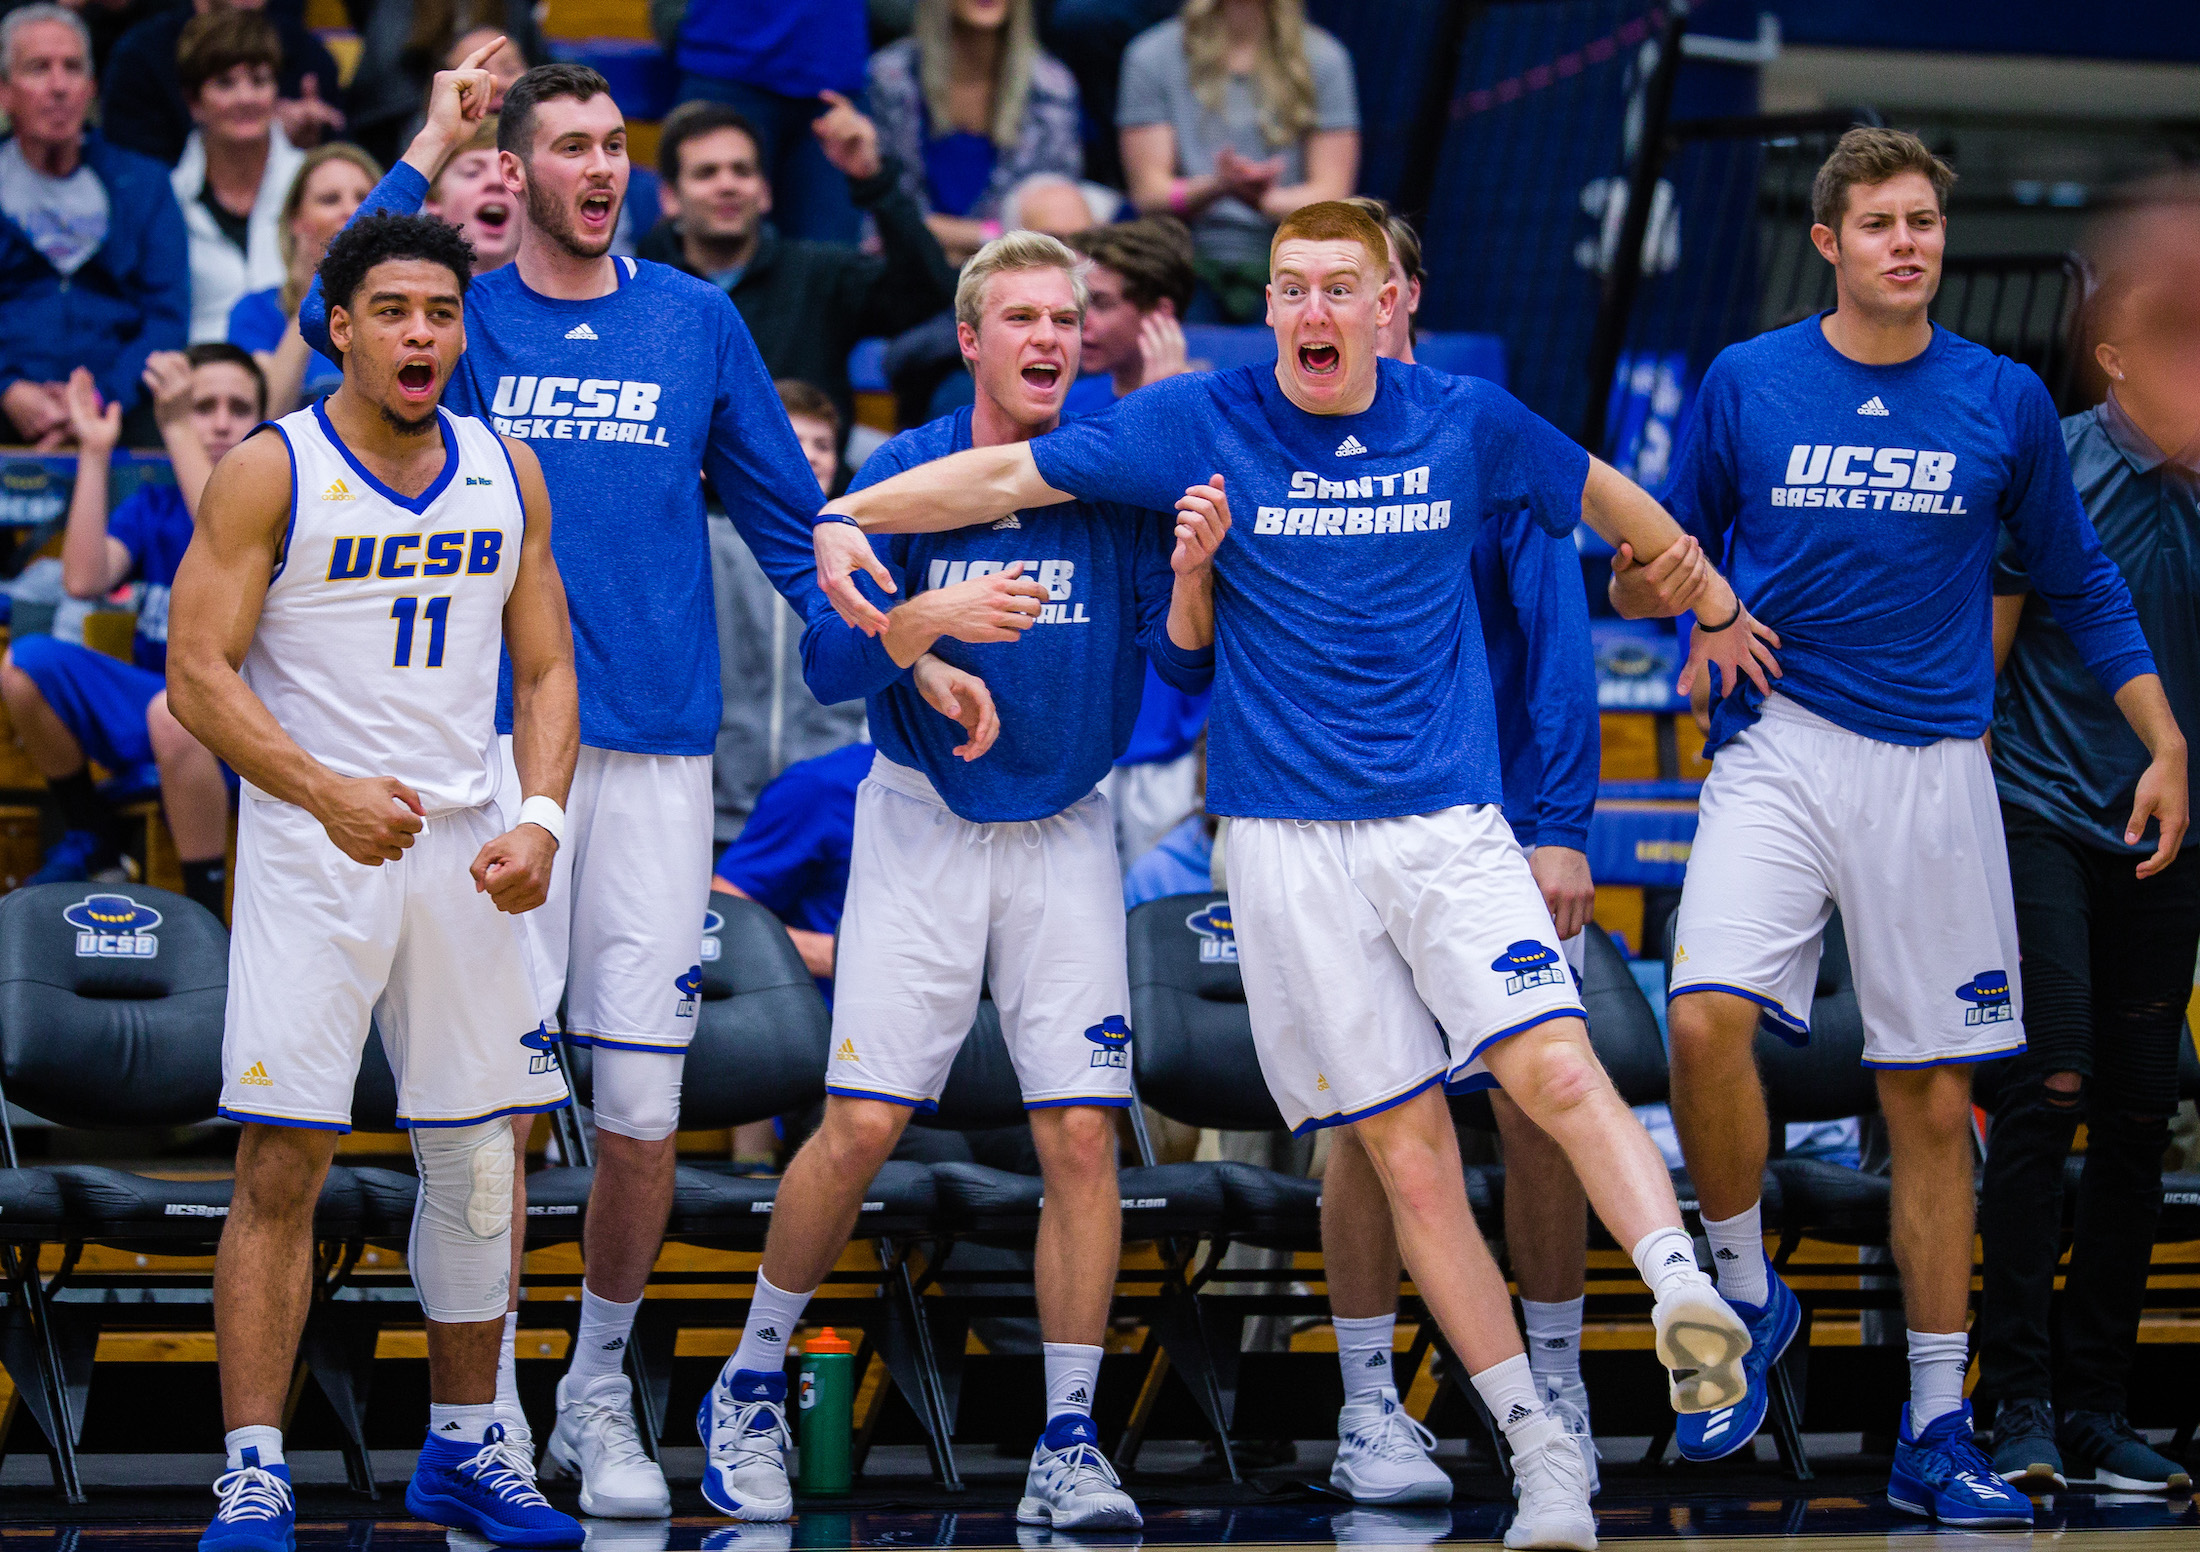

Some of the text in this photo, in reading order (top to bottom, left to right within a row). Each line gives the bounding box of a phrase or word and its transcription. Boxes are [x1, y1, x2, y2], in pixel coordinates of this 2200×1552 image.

[491, 376, 661, 421] UCSB
[490, 415, 670, 448] ASKETBALL
[1335, 446, 1368, 457] adidas
[1287, 465, 1431, 499] SANTA
[1785, 445, 1957, 491] UCSB
[321, 493, 356, 501] adidas
[1771, 487, 1967, 515] BASKETBALL
[1253, 500, 1451, 536] BARBARA
[325, 529, 505, 582] UCSB
[389, 595, 452, 668] 11
[78, 932, 156, 956] UCSB
[1201, 939, 1239, 961] UC
[1506, 968, 1565, 996] UCSB
[1965, 1003, 2012, 1026] UCS
[529, 1053, 560, 1074] UC
[1091, 1050, 1127, 1069] UCS
